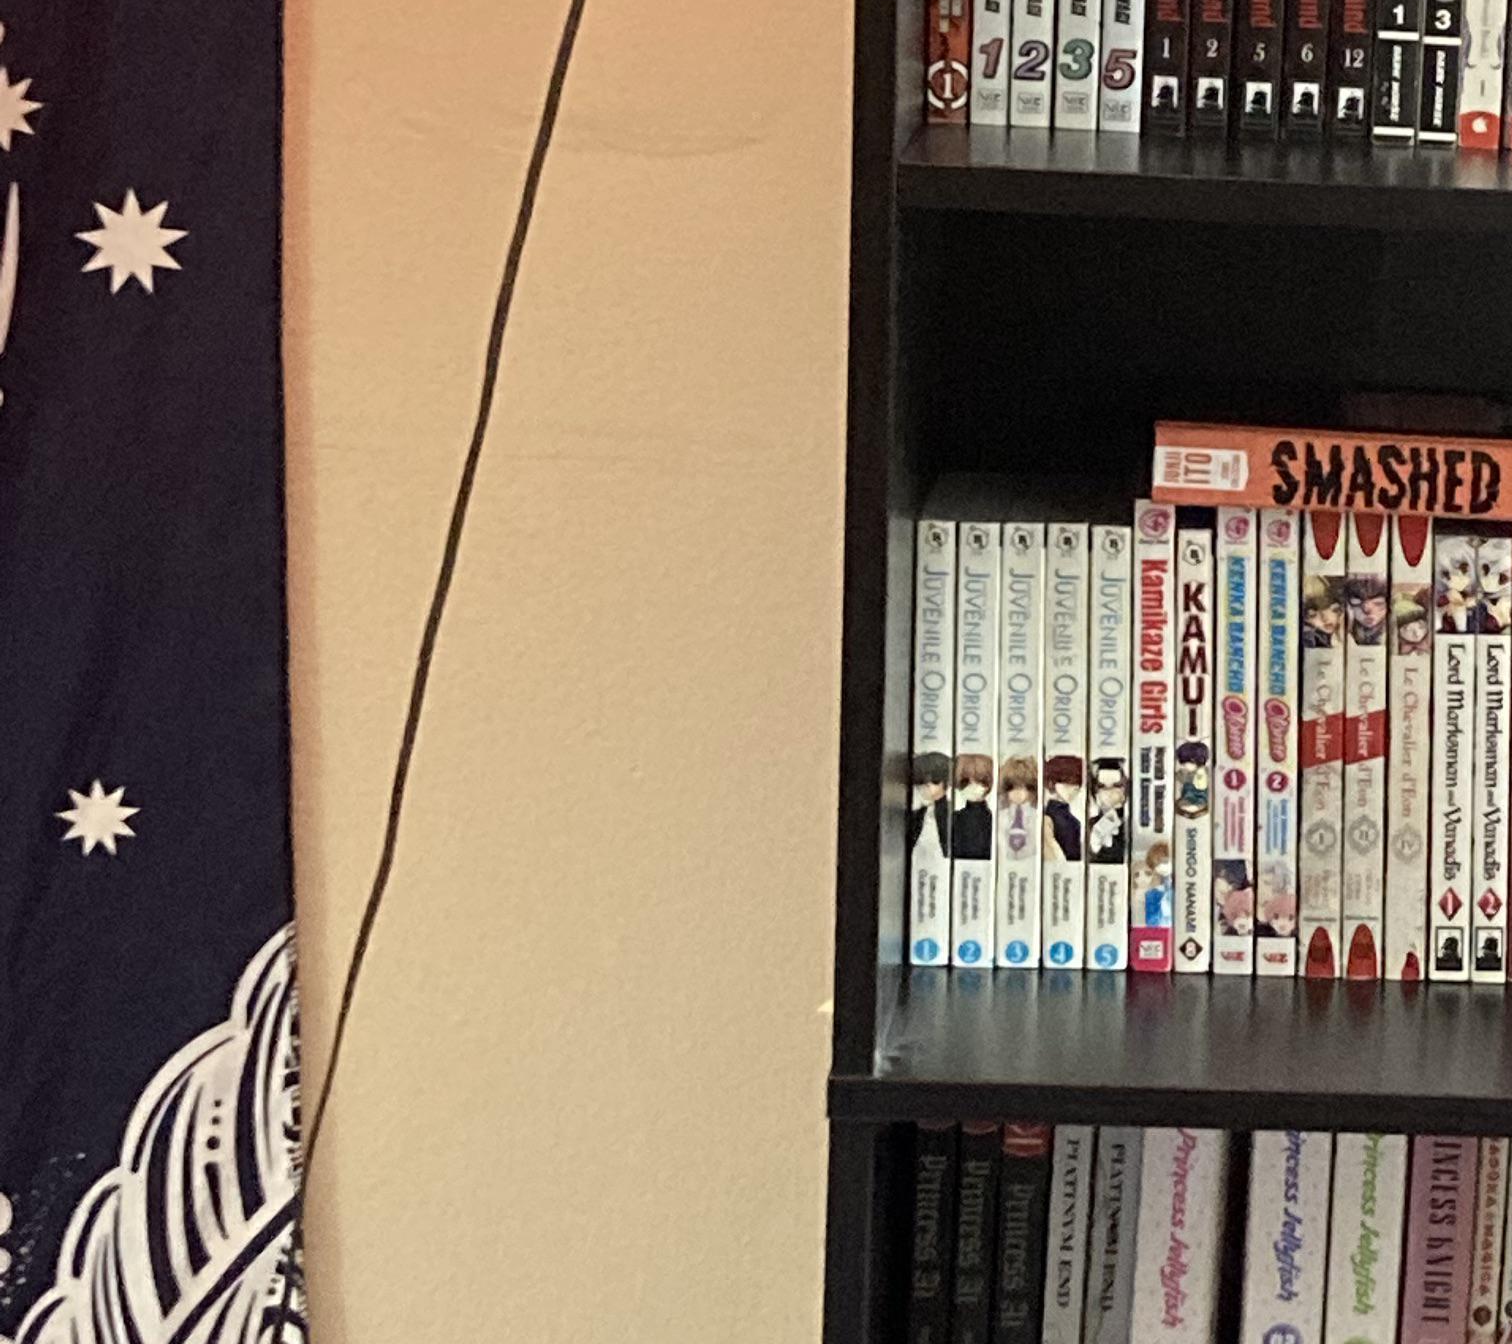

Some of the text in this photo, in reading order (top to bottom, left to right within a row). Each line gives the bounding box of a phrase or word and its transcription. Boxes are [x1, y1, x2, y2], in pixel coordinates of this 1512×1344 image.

[980, 38, 1004, 80] 1
[1014, 40, 1049, 81] 2
[1059, 38, 1094, 80] 3
[1102, 48, 1137, 90] 5
[1344, 47, 1364, 68] 12
[1271, 440, 1501, 515] SMASHED
[1141, 559, 1169, 672] Kamikaze
[1178, 583, 1209, 737] KAMUI
[920, 671, 946, 742] ORION
[961, 672, 987, 744] ORION
[1008, 672, 1032, 744] ORION
[1053, 674, 1078, 744] ORION
[1098, 677, 1124, 747] ORION
[1139, 682, 1168, 736] Girls
[1160, 1233, 1190, 1329] Jellyfish
[1274, 1208, 1302, 1302] Jellyfish
